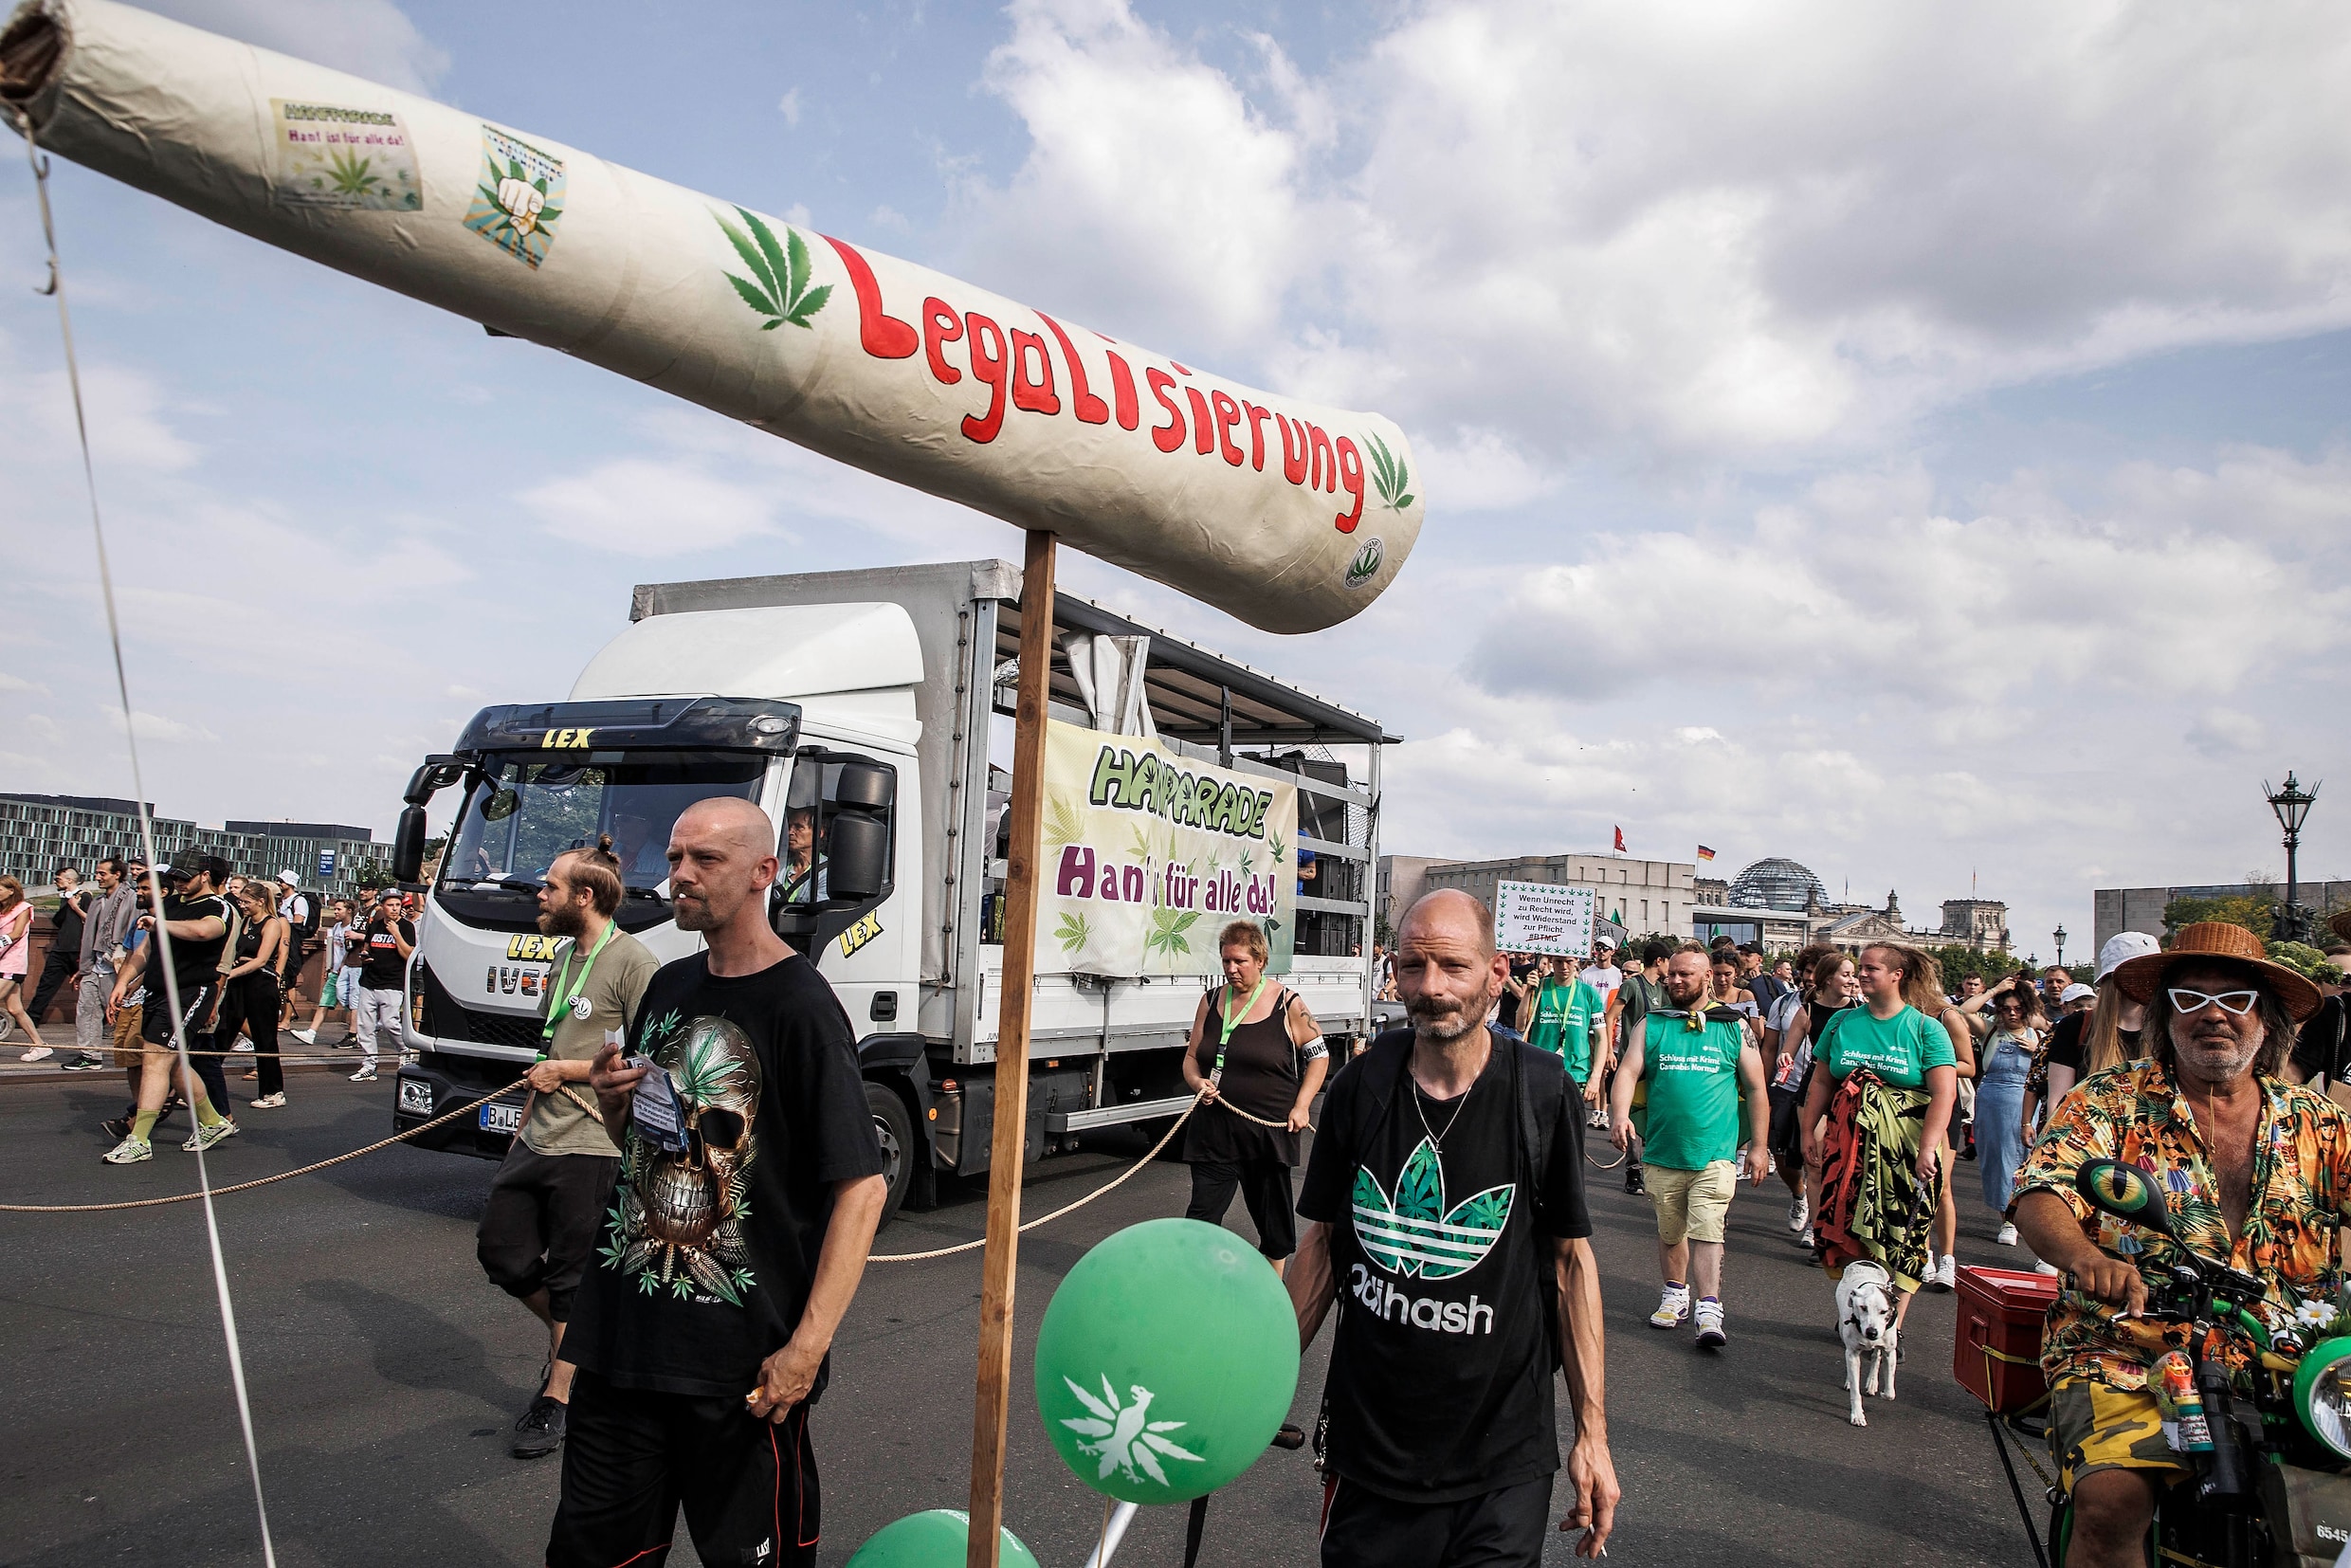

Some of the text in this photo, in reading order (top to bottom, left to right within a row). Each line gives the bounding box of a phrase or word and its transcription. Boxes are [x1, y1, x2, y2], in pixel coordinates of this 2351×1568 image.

[541, 729, 597, 749] LEX
[1165, 862, 1198, 908] für
[1205, 869, 1241, 913] alle
[1247, 873, 1276, 915] da!
[1519, 894, 1575, 906] Wenn Unrecht
[1529, 904, 1553, 914] Recht
[1555, 906, 1574, 916] wird,
[1513, 913, 1577, 925] wird Widerstand
[839, 909, 884, 958] LEX
[1538, 923, 1565, 934] Pflicht.
[507, 935, 561, 963] LEX
[1842, 1050, 1871, 1060] Schluss
[1886, 1055, 1908, 1066] Krimi.
[1660, 1063, 1690, 1071] Cannabis
[1877, 1063, 1909, 1075] Normal!
[489, 1107, 497, 1124] B
